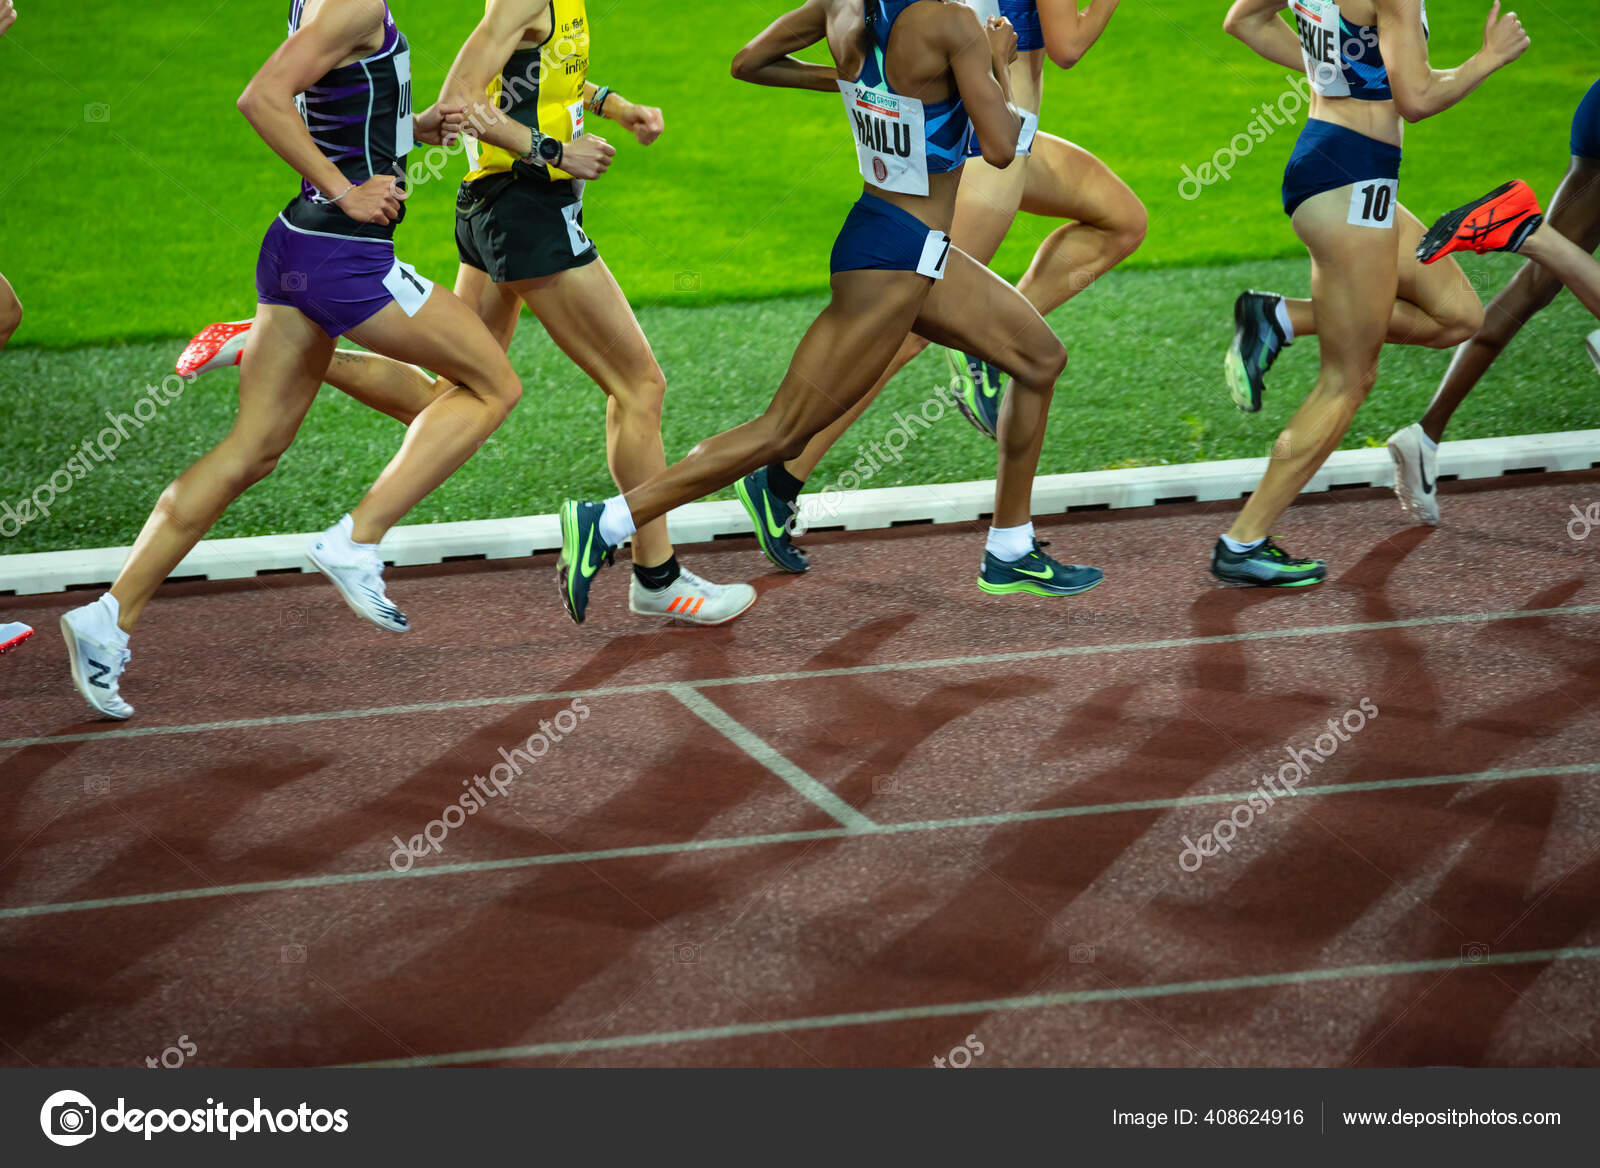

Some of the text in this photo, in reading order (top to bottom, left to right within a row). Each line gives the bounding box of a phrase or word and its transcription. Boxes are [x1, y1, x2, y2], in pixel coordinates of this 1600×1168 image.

[876, 95, 897, 108] GROUP
[852, 108, 911, 158] HAILU
[1361, 184, 1391, 222] 10
[934, 235, 951, 271] 7
[399, 266, 426, 295] 1
